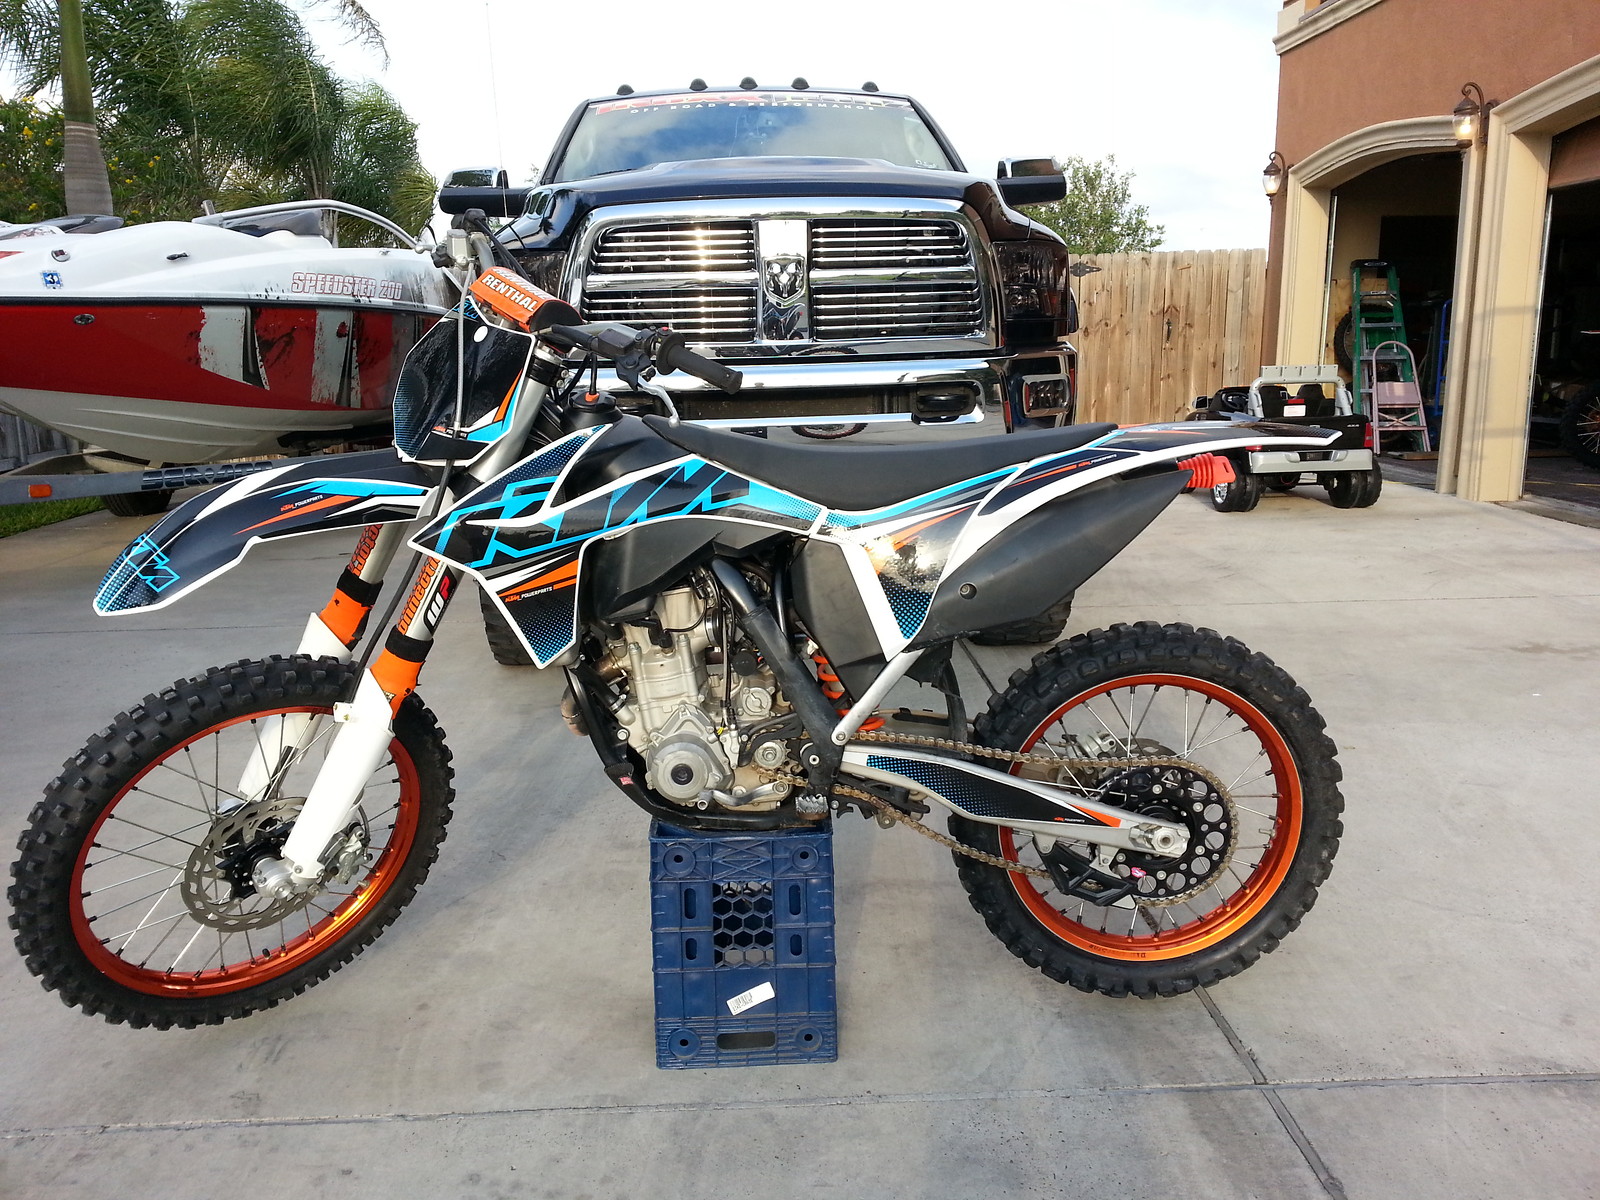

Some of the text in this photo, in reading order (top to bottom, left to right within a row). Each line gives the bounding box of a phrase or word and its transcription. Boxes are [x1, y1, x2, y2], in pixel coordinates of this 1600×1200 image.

[748, 102, 875, 111] PERFORMANCE
[291, 272, 402, 300] SPEEDSTER 200
[481, 274, 538, 312] RENTHAL
